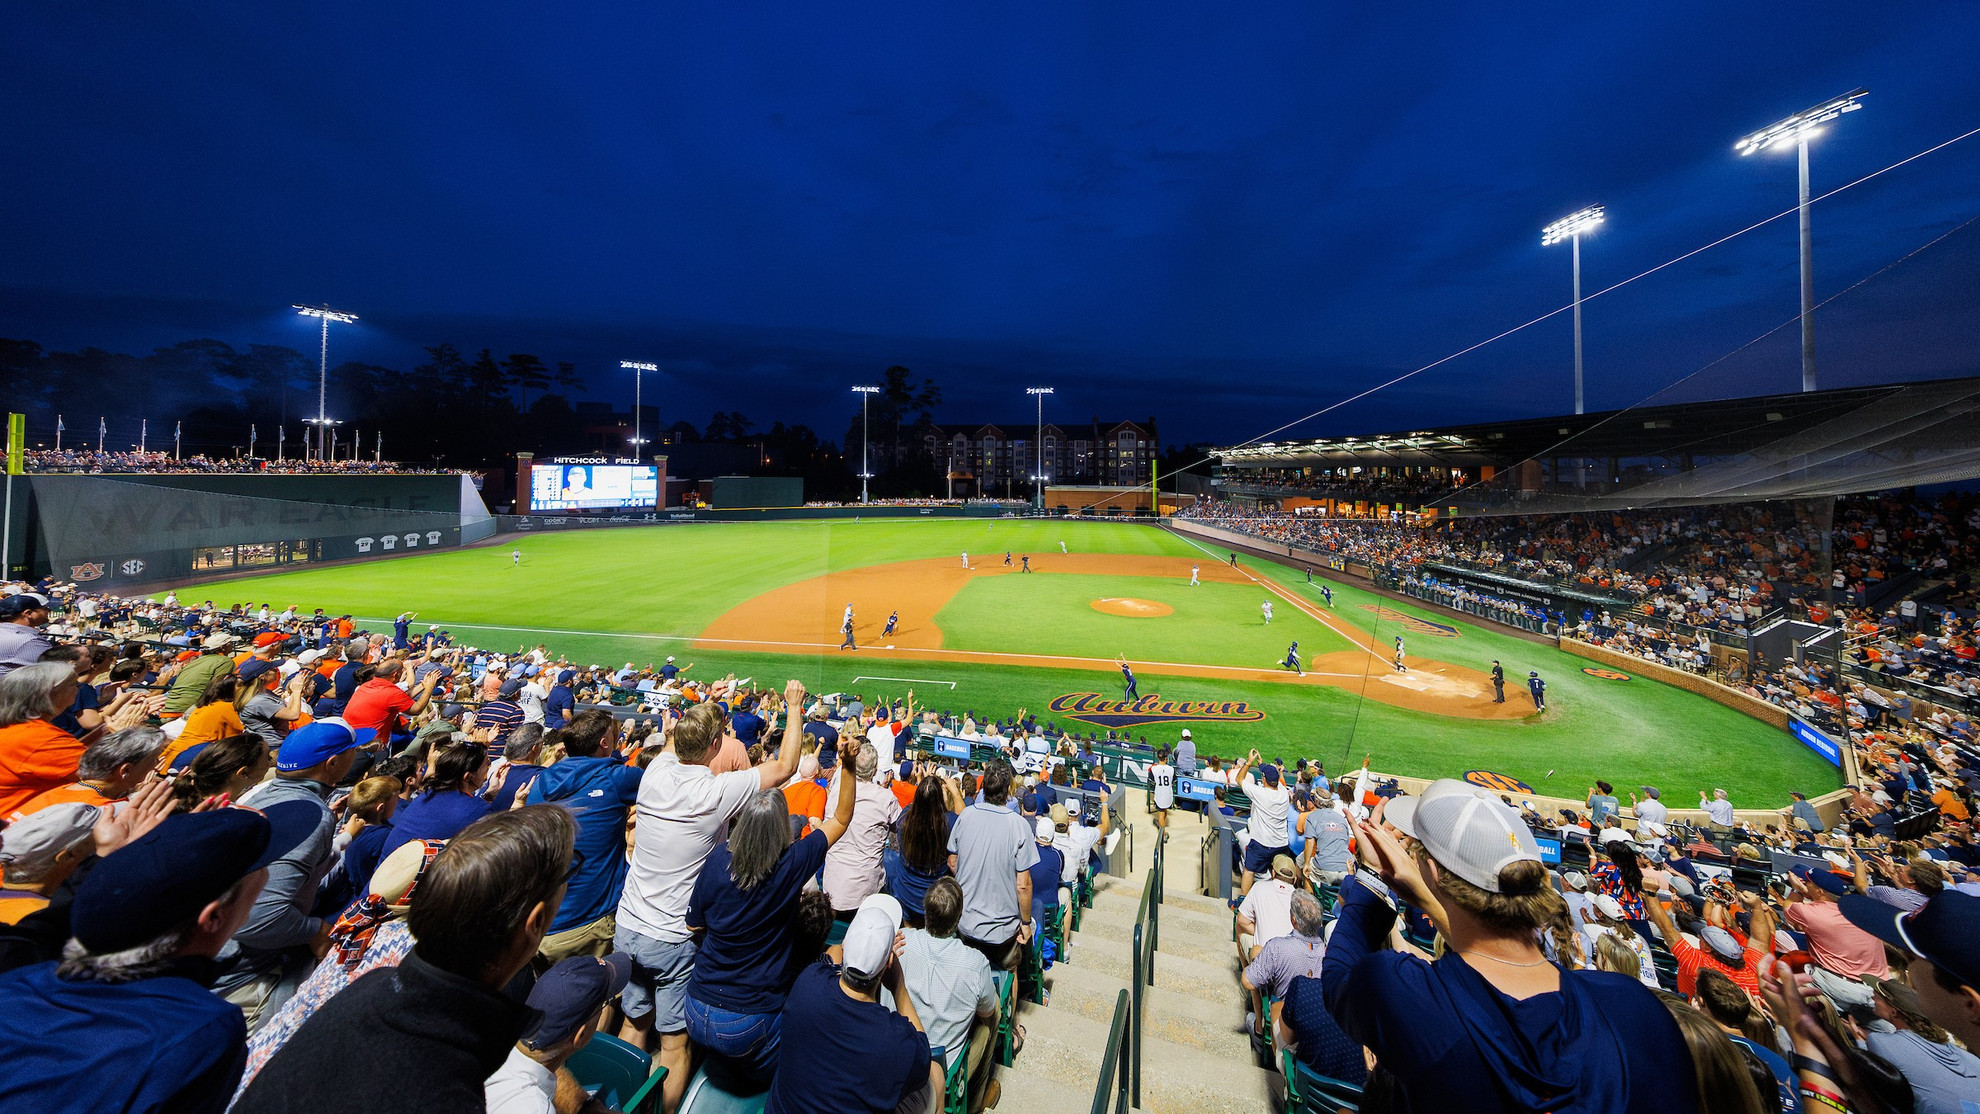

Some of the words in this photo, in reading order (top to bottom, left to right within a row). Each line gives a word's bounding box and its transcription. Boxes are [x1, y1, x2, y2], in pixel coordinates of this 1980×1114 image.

[553, 457, 608, 465] HITCHCOCK
[86, 498, 253, 536] WAR
[279, 495, 430, 525] EAGLE
[121, 559, 145, 575] SEC
[1048, 693, 1262, 721] Auburn
[945, 744, 968, 753] BASEBALL
[1158, 775, 1170, 787] 18
[1192, 786, 1215, 795] BASEBA
[1539, 845, 1556, 856] BALL
